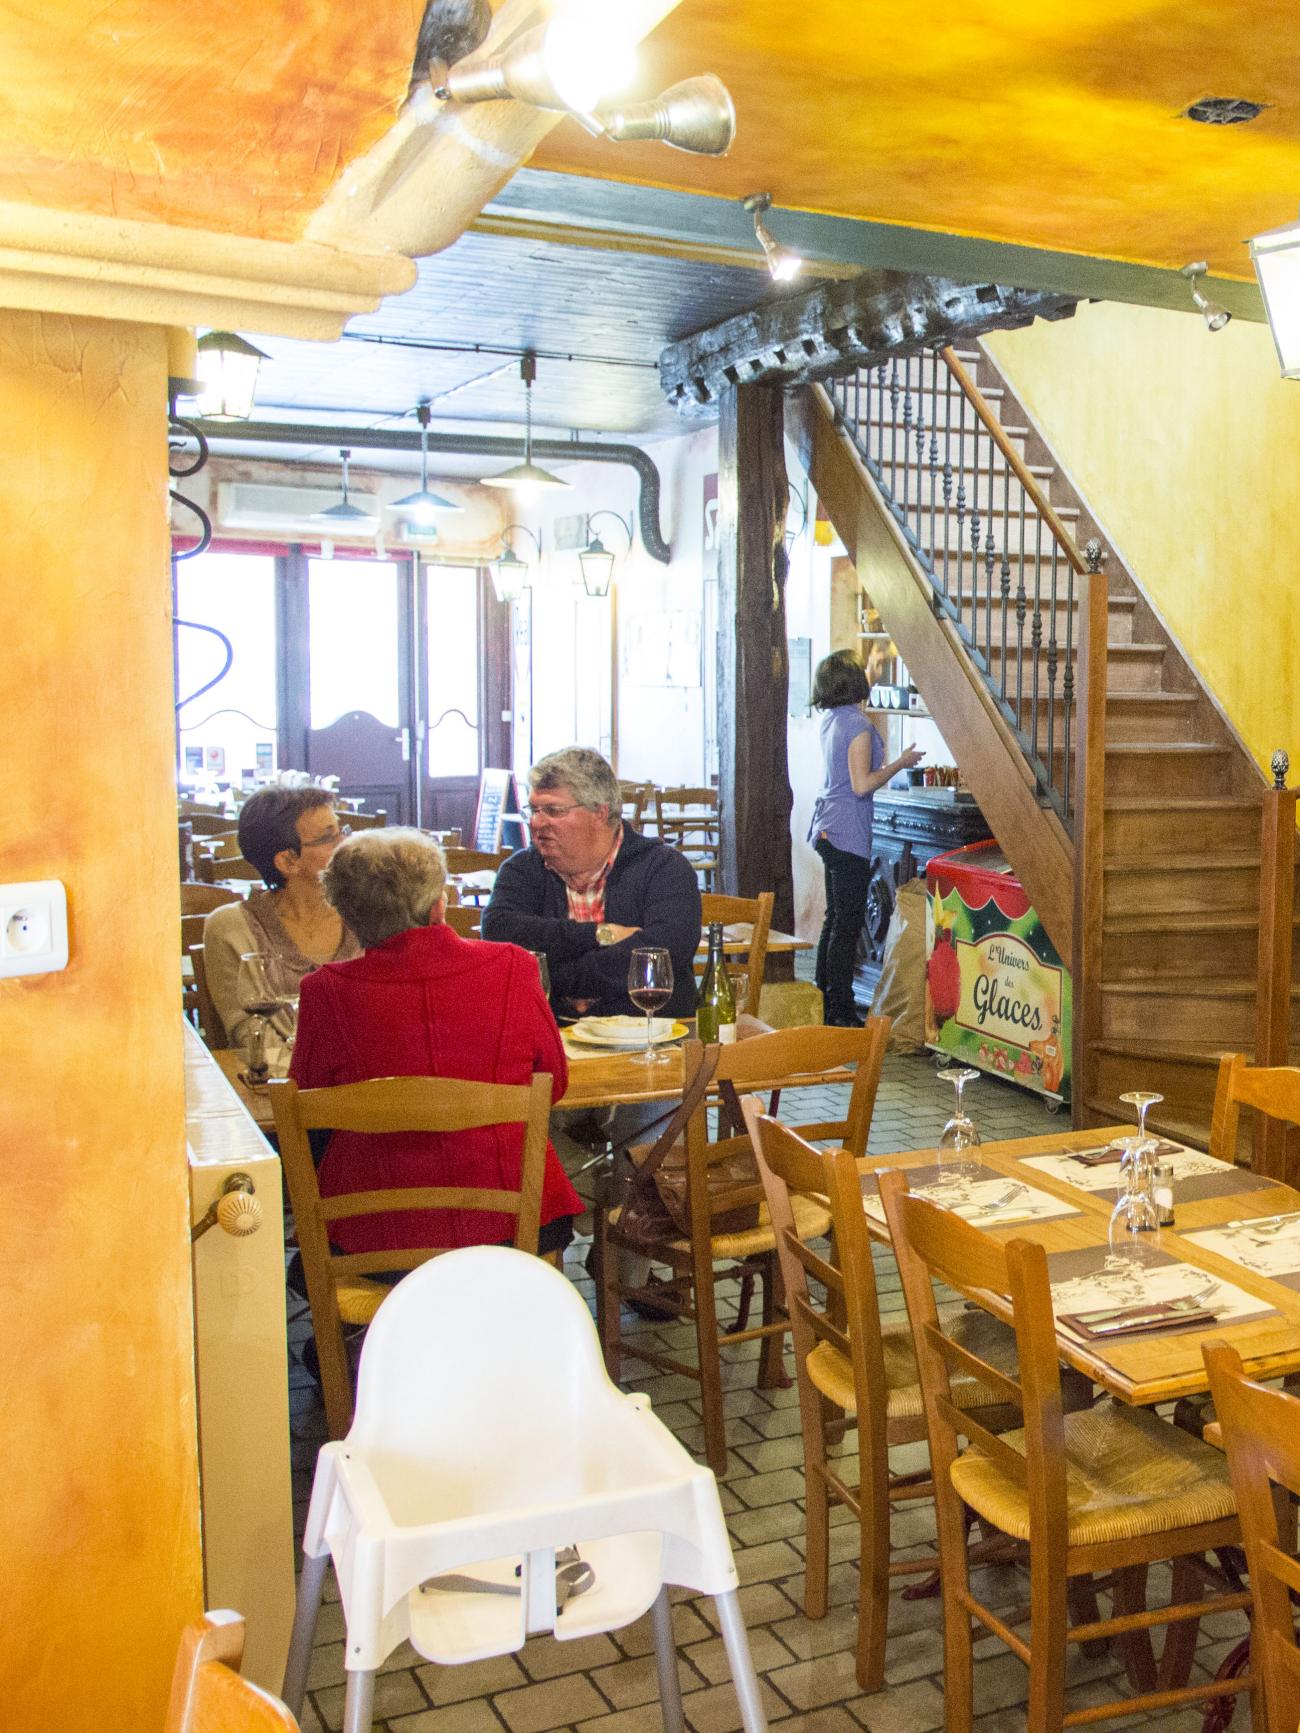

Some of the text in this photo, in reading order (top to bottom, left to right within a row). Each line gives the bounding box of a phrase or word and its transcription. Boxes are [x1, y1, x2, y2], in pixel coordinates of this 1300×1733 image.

[988, 944, 1030, 972] L'Univers
[1004, 975, 1014, 989] des
[973, 974, 1042, 1030] Glaces
